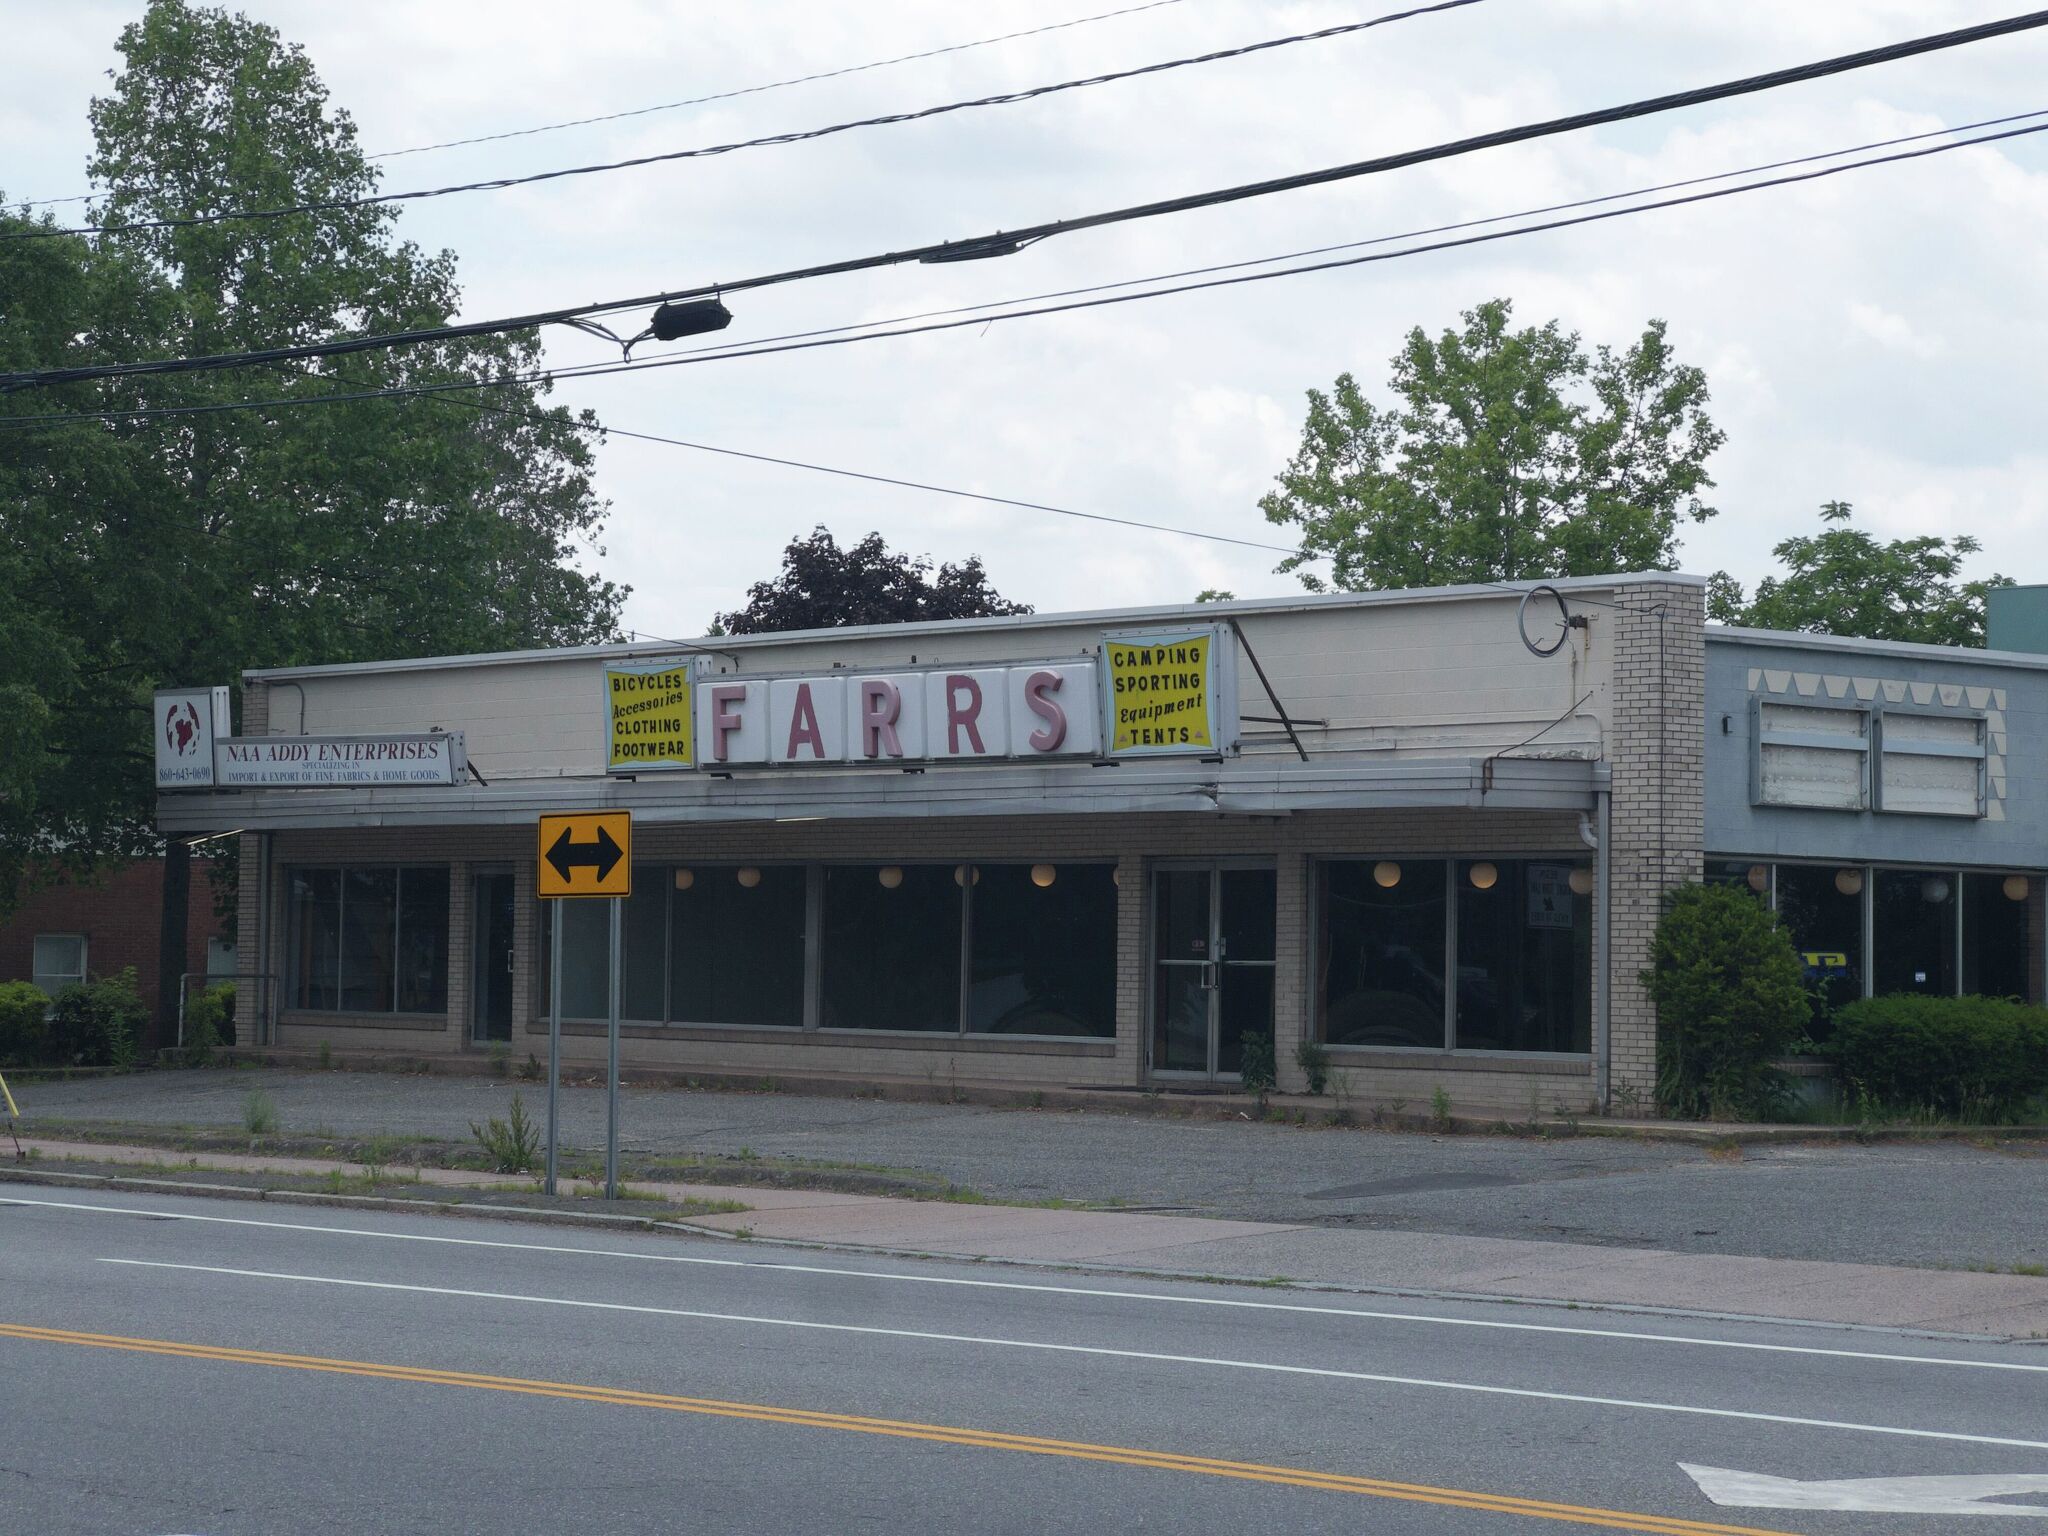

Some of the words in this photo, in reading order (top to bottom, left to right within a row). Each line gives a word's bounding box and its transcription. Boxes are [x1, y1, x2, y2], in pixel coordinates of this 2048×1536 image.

[1114, 648, 1200, 667] CAMPING
[613, 675, 682, 692] BICYCLES
[1115, 673, 1200, 692] SPORTING
[712, 670, 1067, 761] FARRS
[1120, 693, 1202, 723] Equipment
[616, 719, 681, 735] CLOTHING
[1130, 727, 1189, 745] TENTS
[227, 745, 260, 762] NAA
[266, 744, 312, 762] ADDY
[319, 742, 439, 761] ENTERPRISES
[614, 741, 684, 757] FOOTWEAR
[302, 761, 350, 770] SPECIALIZING
[353, 760, 360, 769] IN
[228, 772, 258, 782] IMPORT
[260, 772, 267, 781] &
[269, 772, 299, 781] EXPORT
[302, 772, 313, 781] OF
[315, 771, 334, 781] FINE
[337, 771, 371, 781] FABRICS
[373, 771, 380, 781] &
[382, 770, 409, 780] HOME
[410, 769, 440, 780] GOODS
